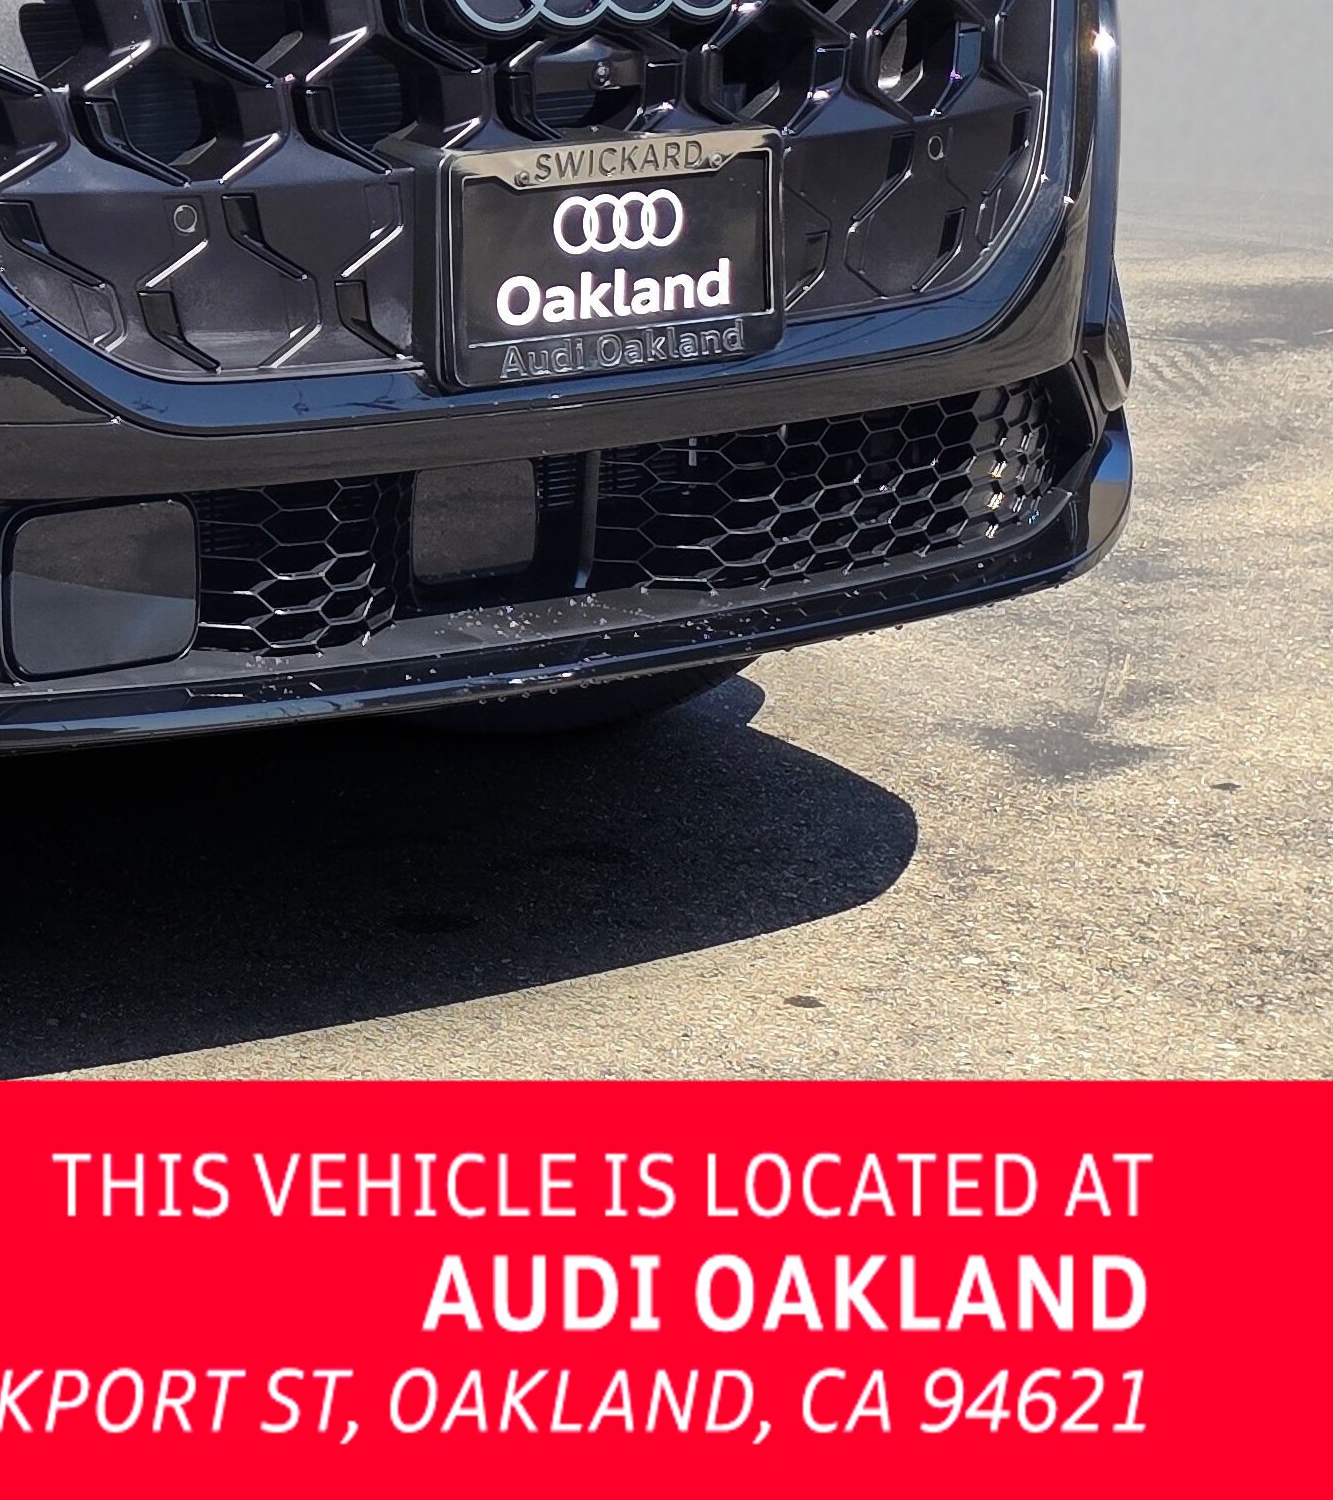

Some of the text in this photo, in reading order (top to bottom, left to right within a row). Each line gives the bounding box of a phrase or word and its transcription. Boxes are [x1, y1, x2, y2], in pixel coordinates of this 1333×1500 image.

[534, 140, 705, 182] SWICKARD
[496, 257, 731, 327] Oakland
[499, 318, 745, 380] Audi Oakland
